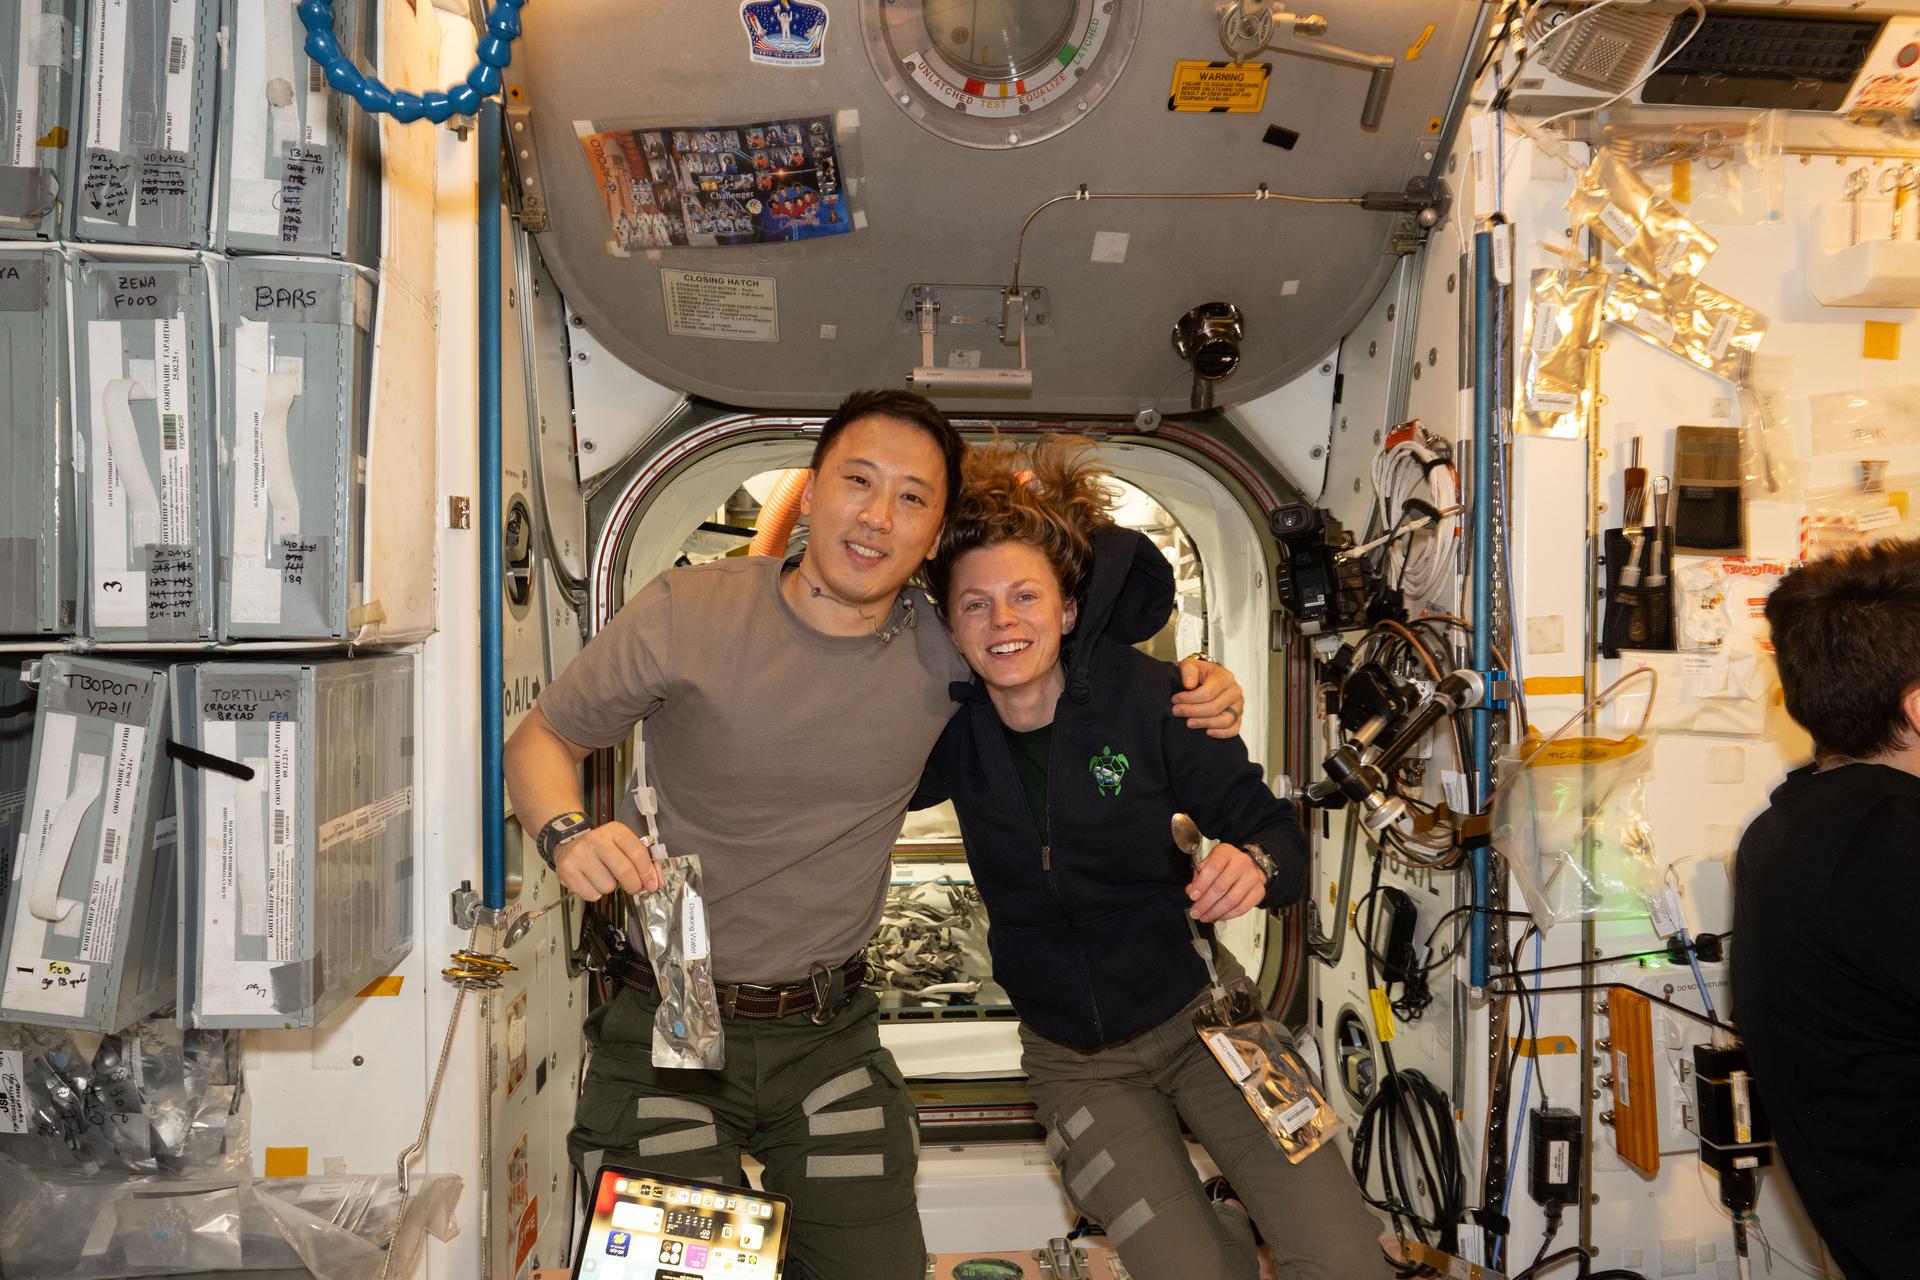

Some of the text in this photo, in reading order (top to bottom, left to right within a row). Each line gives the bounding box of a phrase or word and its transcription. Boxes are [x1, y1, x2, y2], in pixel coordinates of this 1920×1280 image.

[1073, 18, 1100, 65] LATCHED
[918, 62, 974, 105] UNLATCHED
[1200, 72, 1246, 82] WARNING
[1019, 72, 1068, 104] EQUALIZE
[980, 100, 1008, 108] TEST
[710, 190, 754, 200] Challenger
[118, 276, 156, 289] ZENA
[684, 274, 760, 287] CLOSING HATCH
[114, 294, 158, 308] FOOD
[255, 286, 316, 312] BARS
[162, 364, 171, 411] ОКОНЧАНИЕ
[1722, 564, 1785, 576] HUGGIES
[103, 581, 122, 592] 3
[212, 688, 291, 702] TORTILLAS
[204, 703, 258, 712] CRACKERS
[218, 712, 254, 720] BREAD
[112, 727, 130, 814] ОКОНЧАНИЕ ГАРАНТИИ
[124, 762, 134, 787] 16.06.24
[82, 906, 96, 952] КОНТЕЙНЕР
[92, 880, 100, 894] 7233
